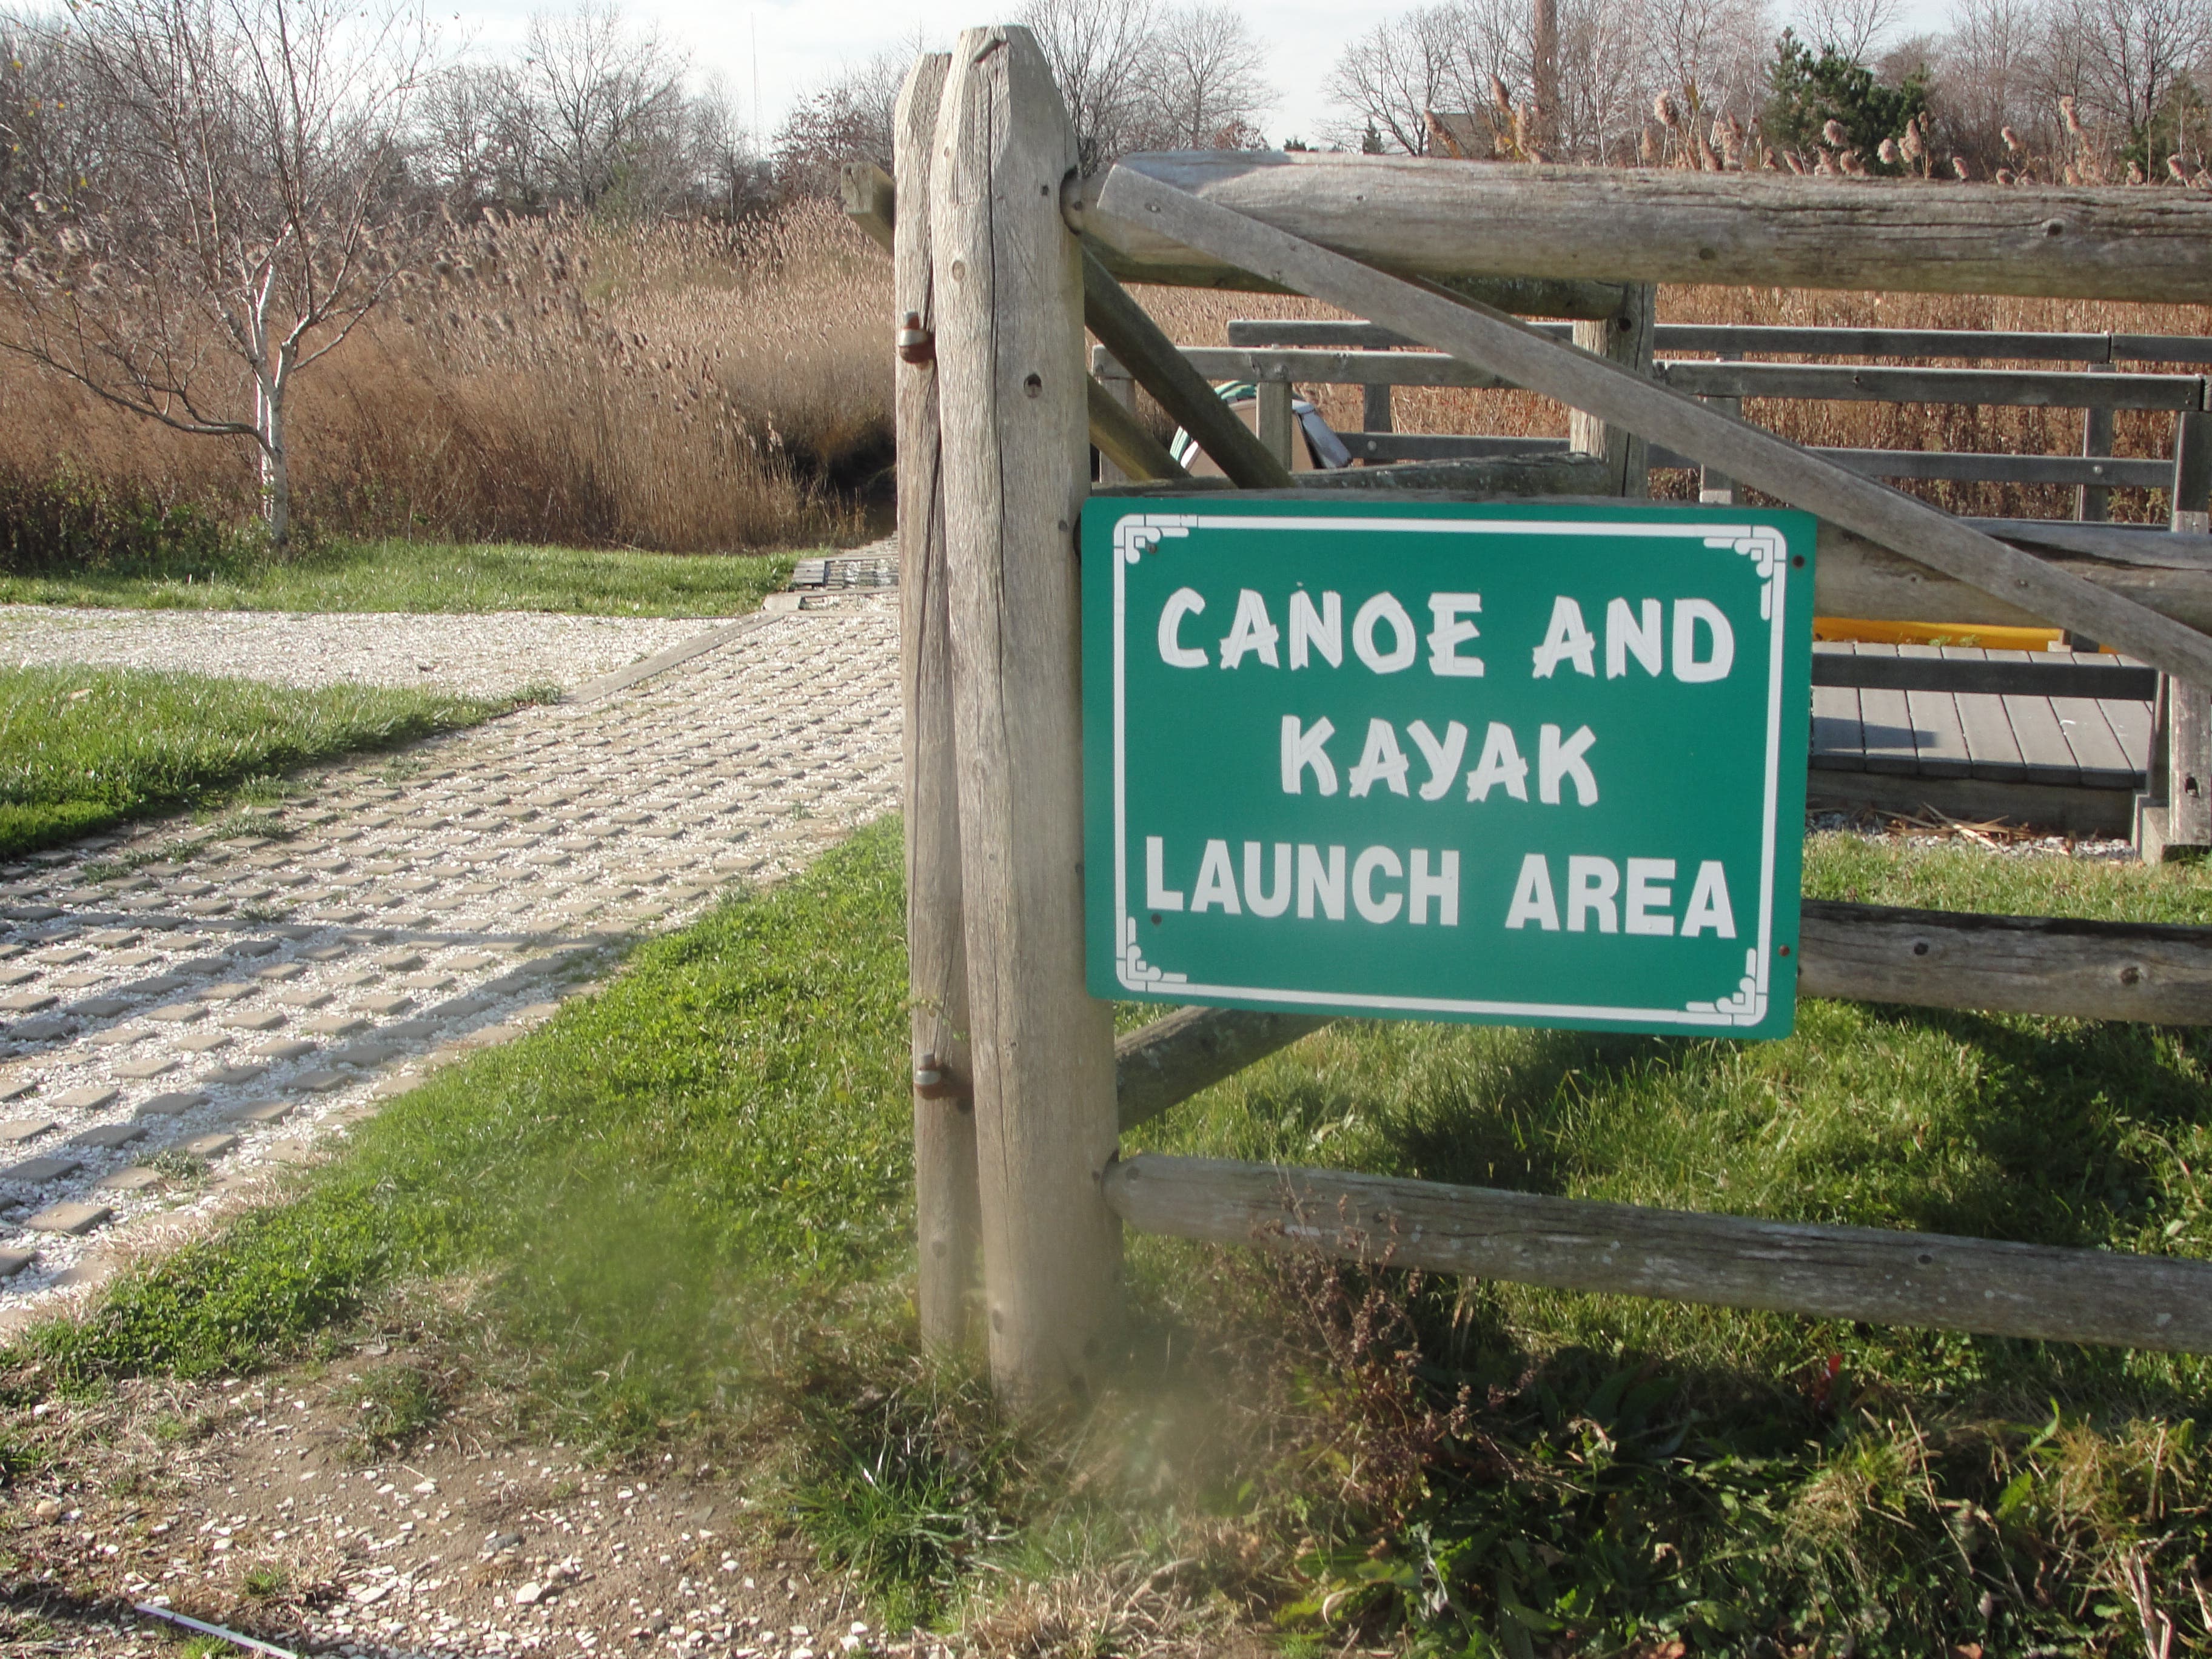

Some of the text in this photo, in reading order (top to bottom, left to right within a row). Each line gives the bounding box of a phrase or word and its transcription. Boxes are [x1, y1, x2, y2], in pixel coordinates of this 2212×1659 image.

[1158, 587, 1735, 682] CANOE AND
[1281, 715, 1598, 806] KAYAK
[1146, 836, 1736, 938] LAUNCH AREA
